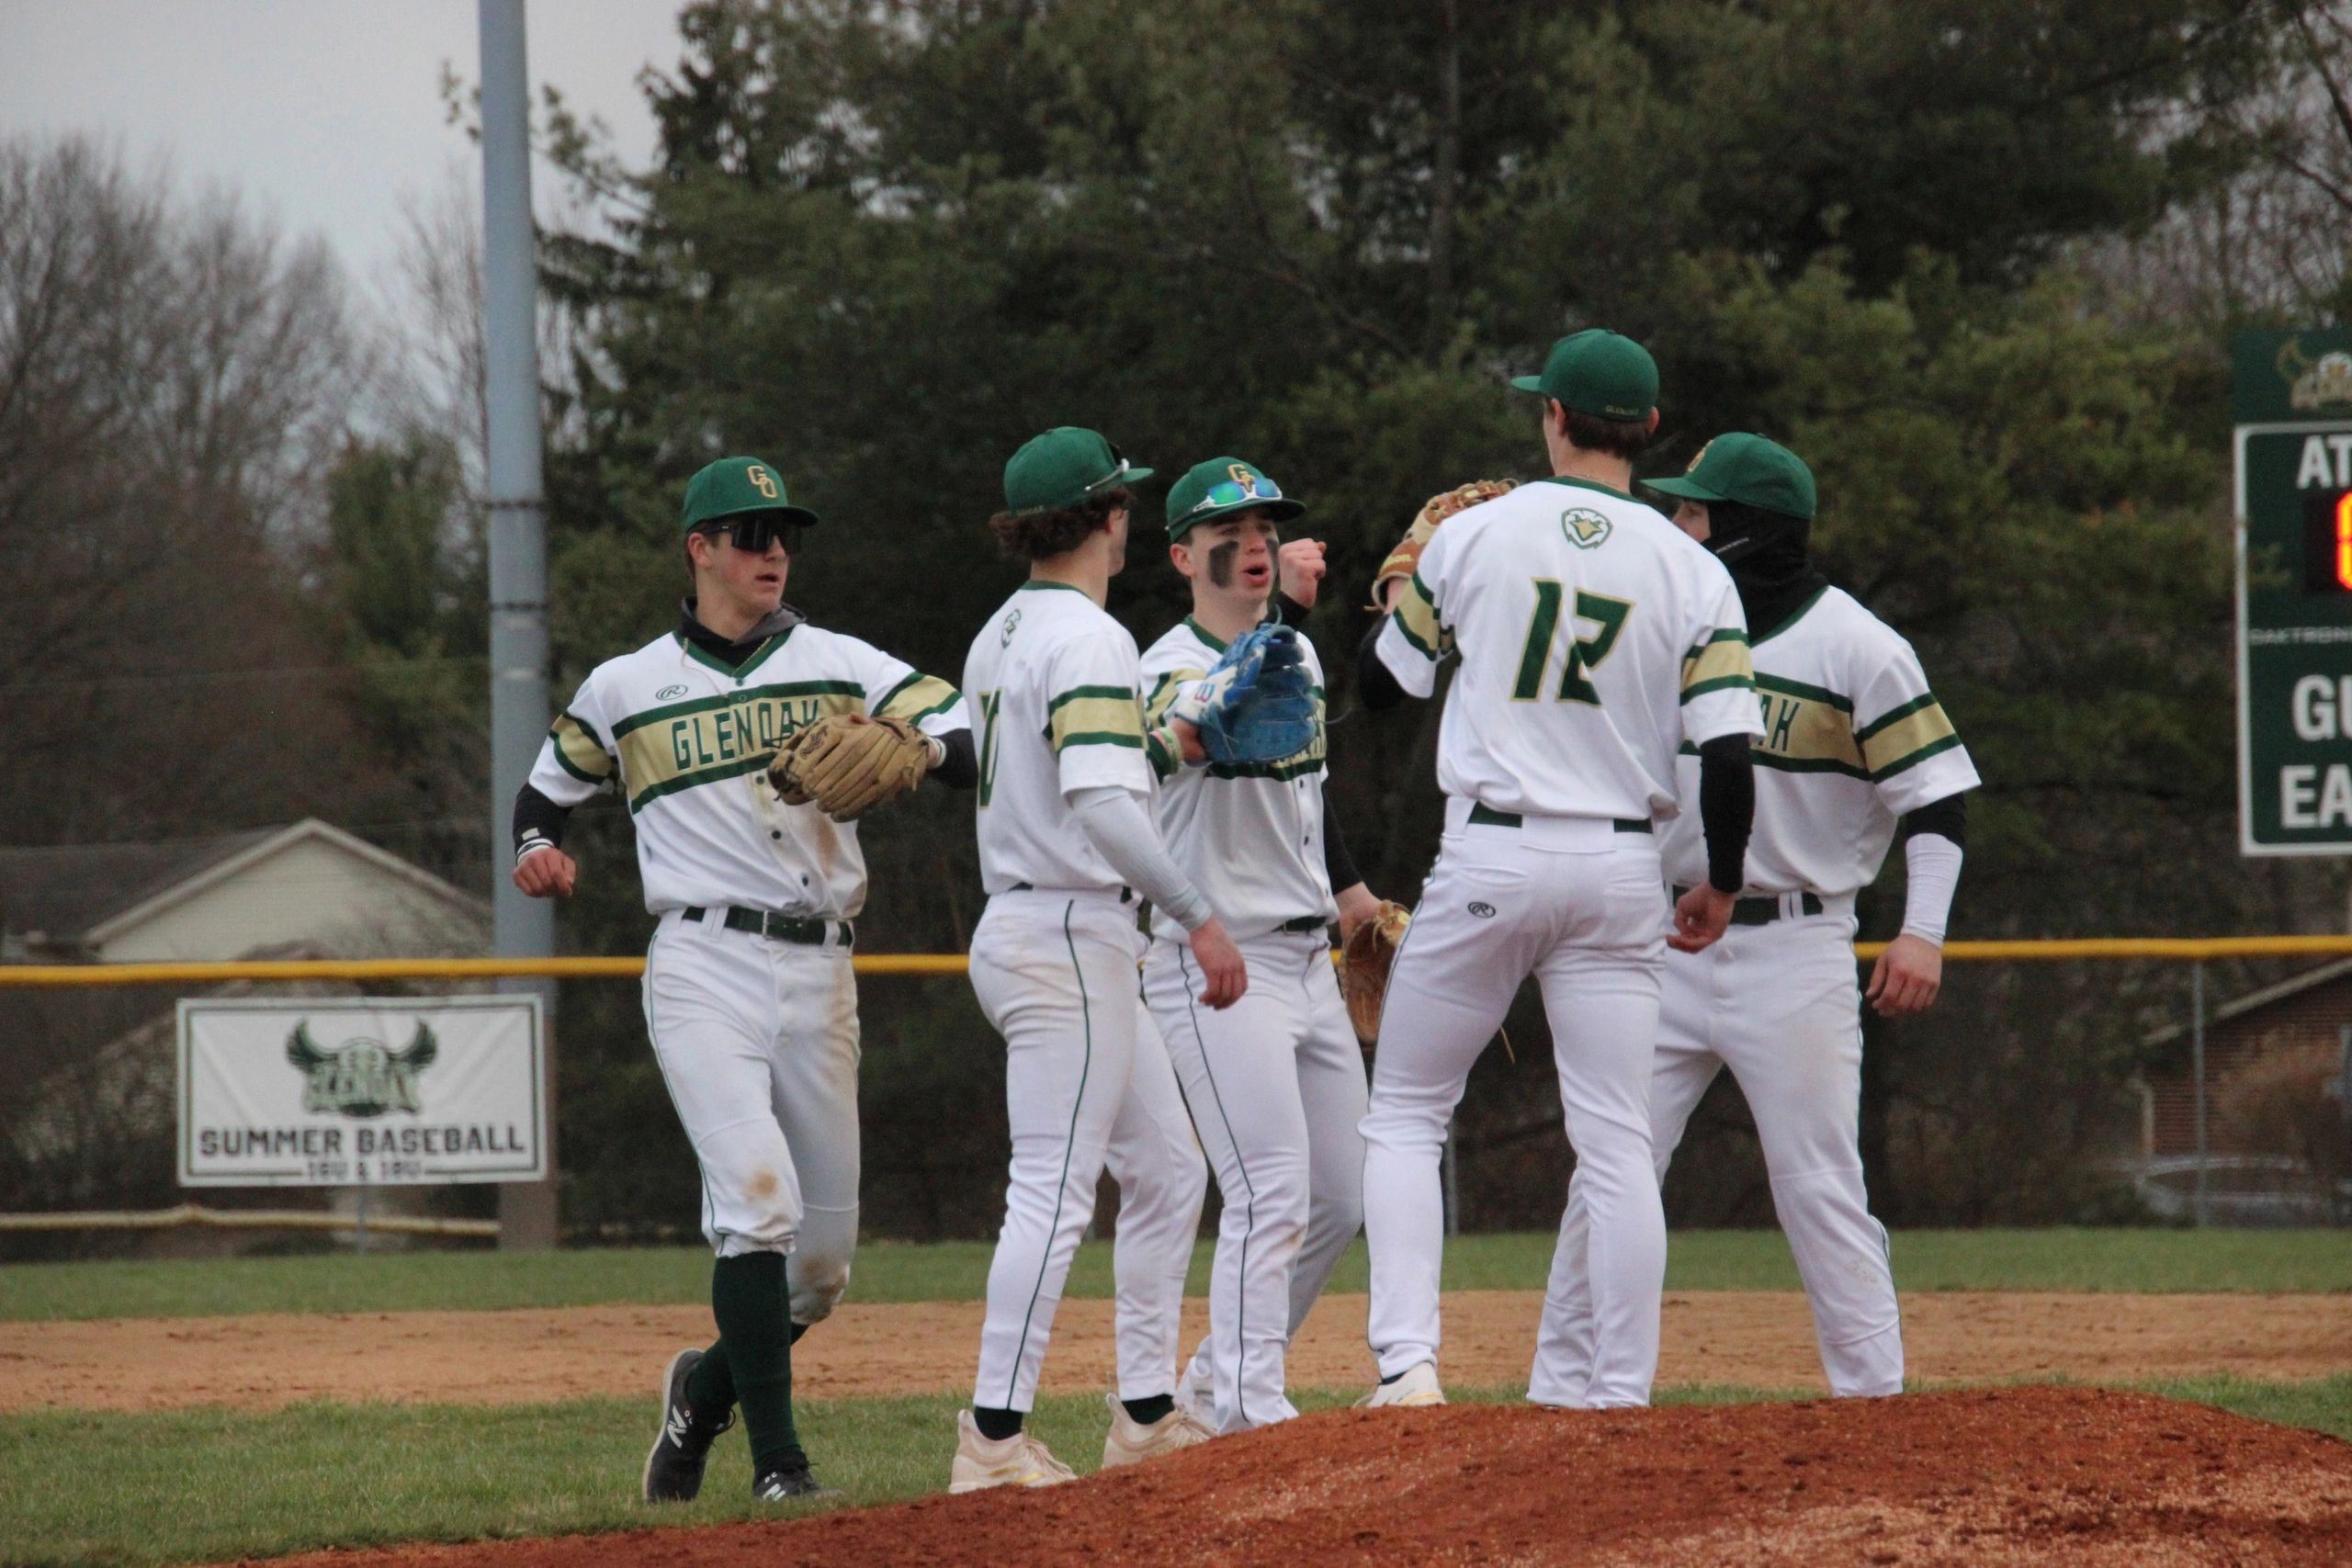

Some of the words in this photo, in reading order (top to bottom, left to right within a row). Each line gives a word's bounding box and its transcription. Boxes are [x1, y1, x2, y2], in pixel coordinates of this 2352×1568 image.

[1510, 577, 1636, 708] 12
[199, 1128, 343, 1157] SUMMER
[356, 1125, 526, 1156] BASEBALL
